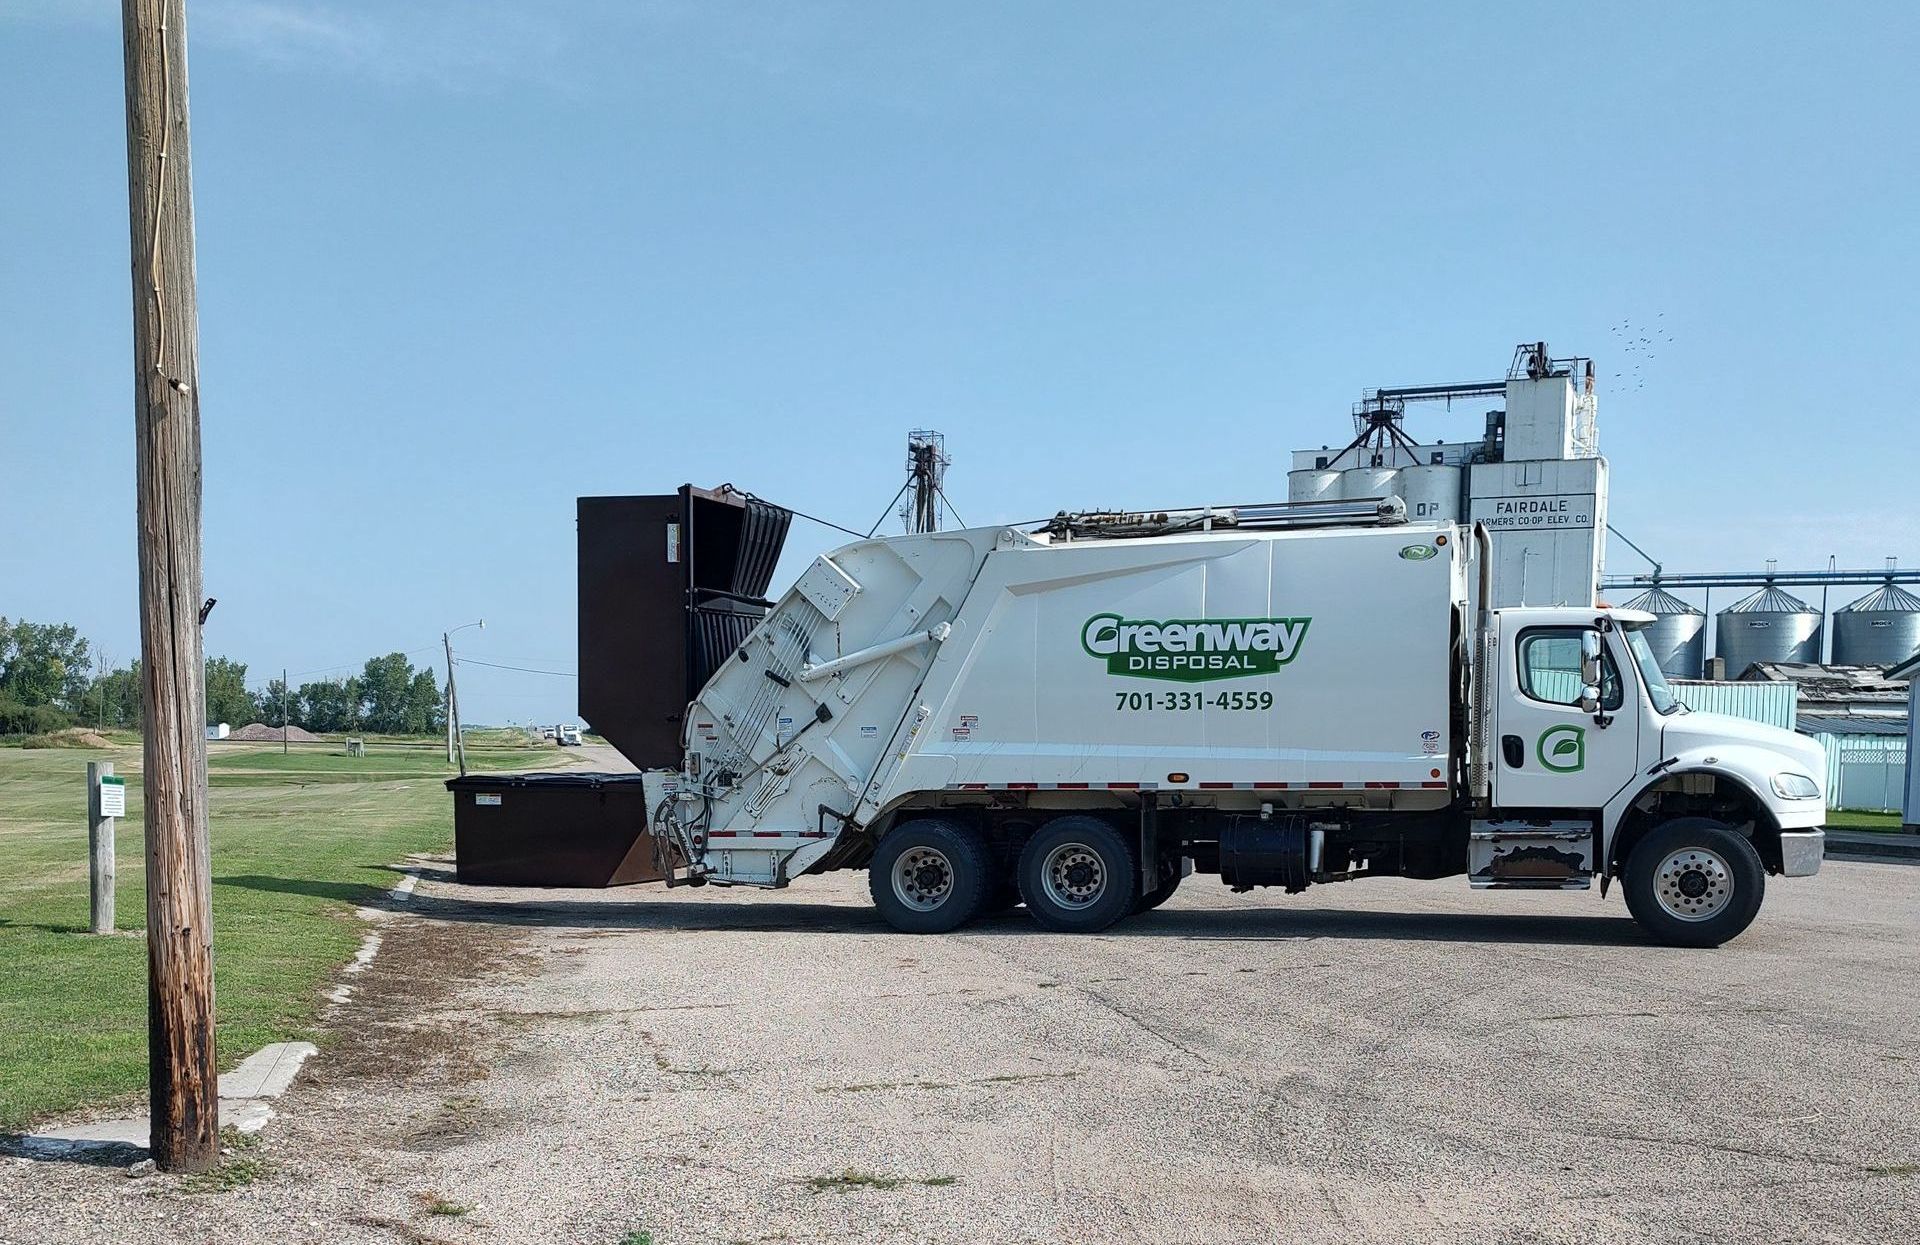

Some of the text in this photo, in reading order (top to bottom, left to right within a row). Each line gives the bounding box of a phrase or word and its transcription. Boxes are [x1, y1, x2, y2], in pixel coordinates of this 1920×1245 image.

[1496, 501, 1567, 514] FAIRDALE
[1084, 616, 1305, 661] Greenway
[1129, 655, 1257, 670] DISPOSAL
[1115, 691, 1273, 711] 701-331-4559
